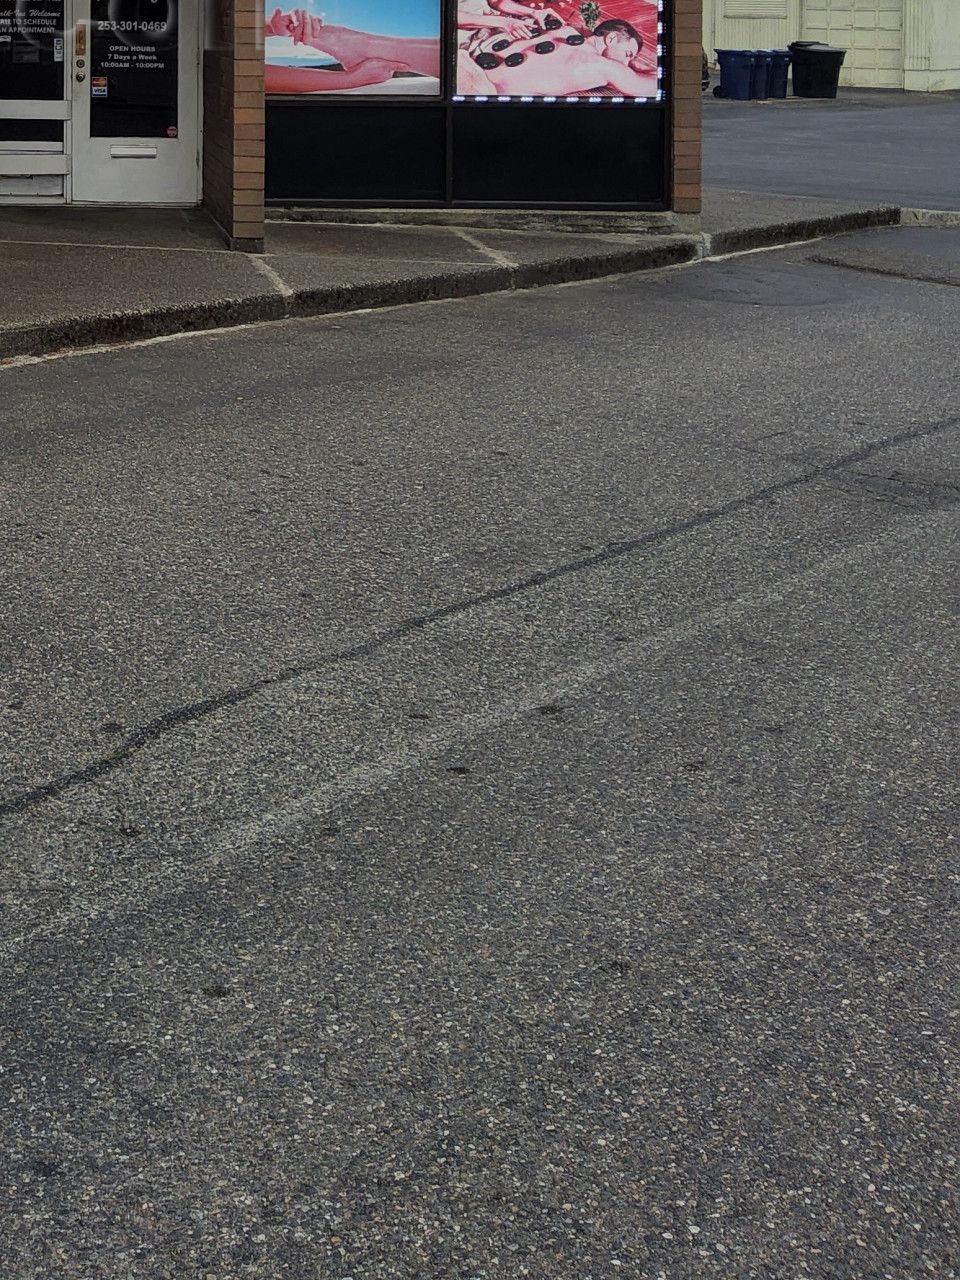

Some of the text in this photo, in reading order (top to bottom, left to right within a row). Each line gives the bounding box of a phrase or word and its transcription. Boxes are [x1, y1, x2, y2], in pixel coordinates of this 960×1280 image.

[23, 18, 56, 26] SCHEDULE
[97, 20, 167, 32] 253-301-0469
[113, 53, 131, 61] Days
